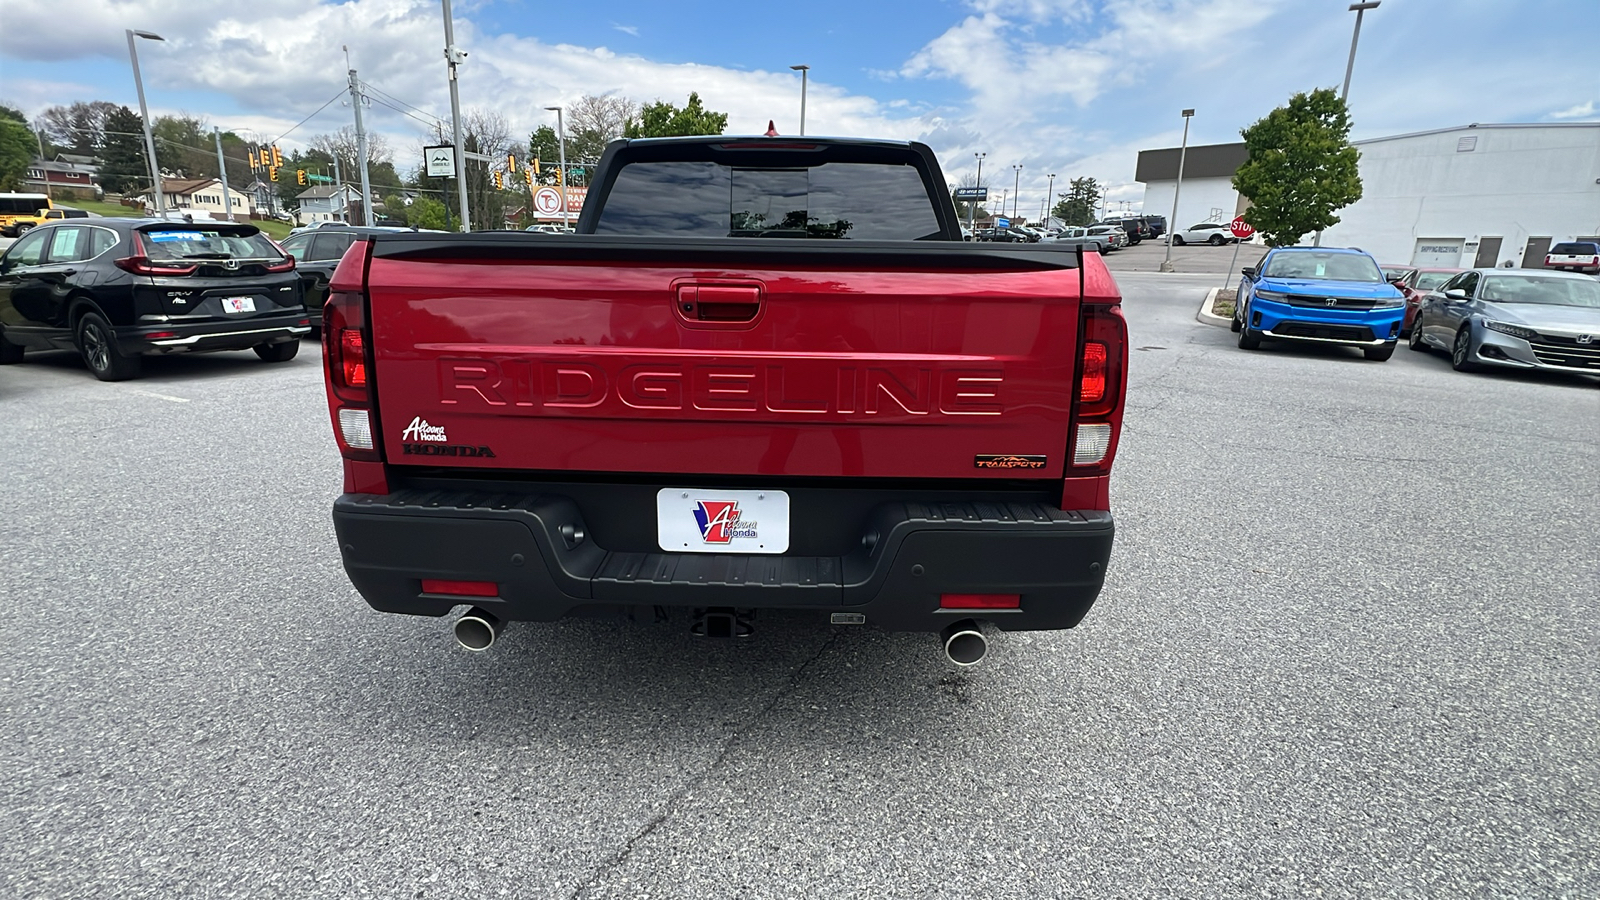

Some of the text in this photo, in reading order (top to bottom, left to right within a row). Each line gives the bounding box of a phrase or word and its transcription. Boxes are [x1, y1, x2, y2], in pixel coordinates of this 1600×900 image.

[438, 357, 1004, 416] RIDGELINE
[402, 416, 445, 441] Altoona
[420, 432, 447, 442] Honda
[402, 443, 497, 458] HONDA
[976, 461, 1045, 469] TRAILSPORT
[704, 504, 758, 538] Altoona
[724, 528, 757, 538] Honda
